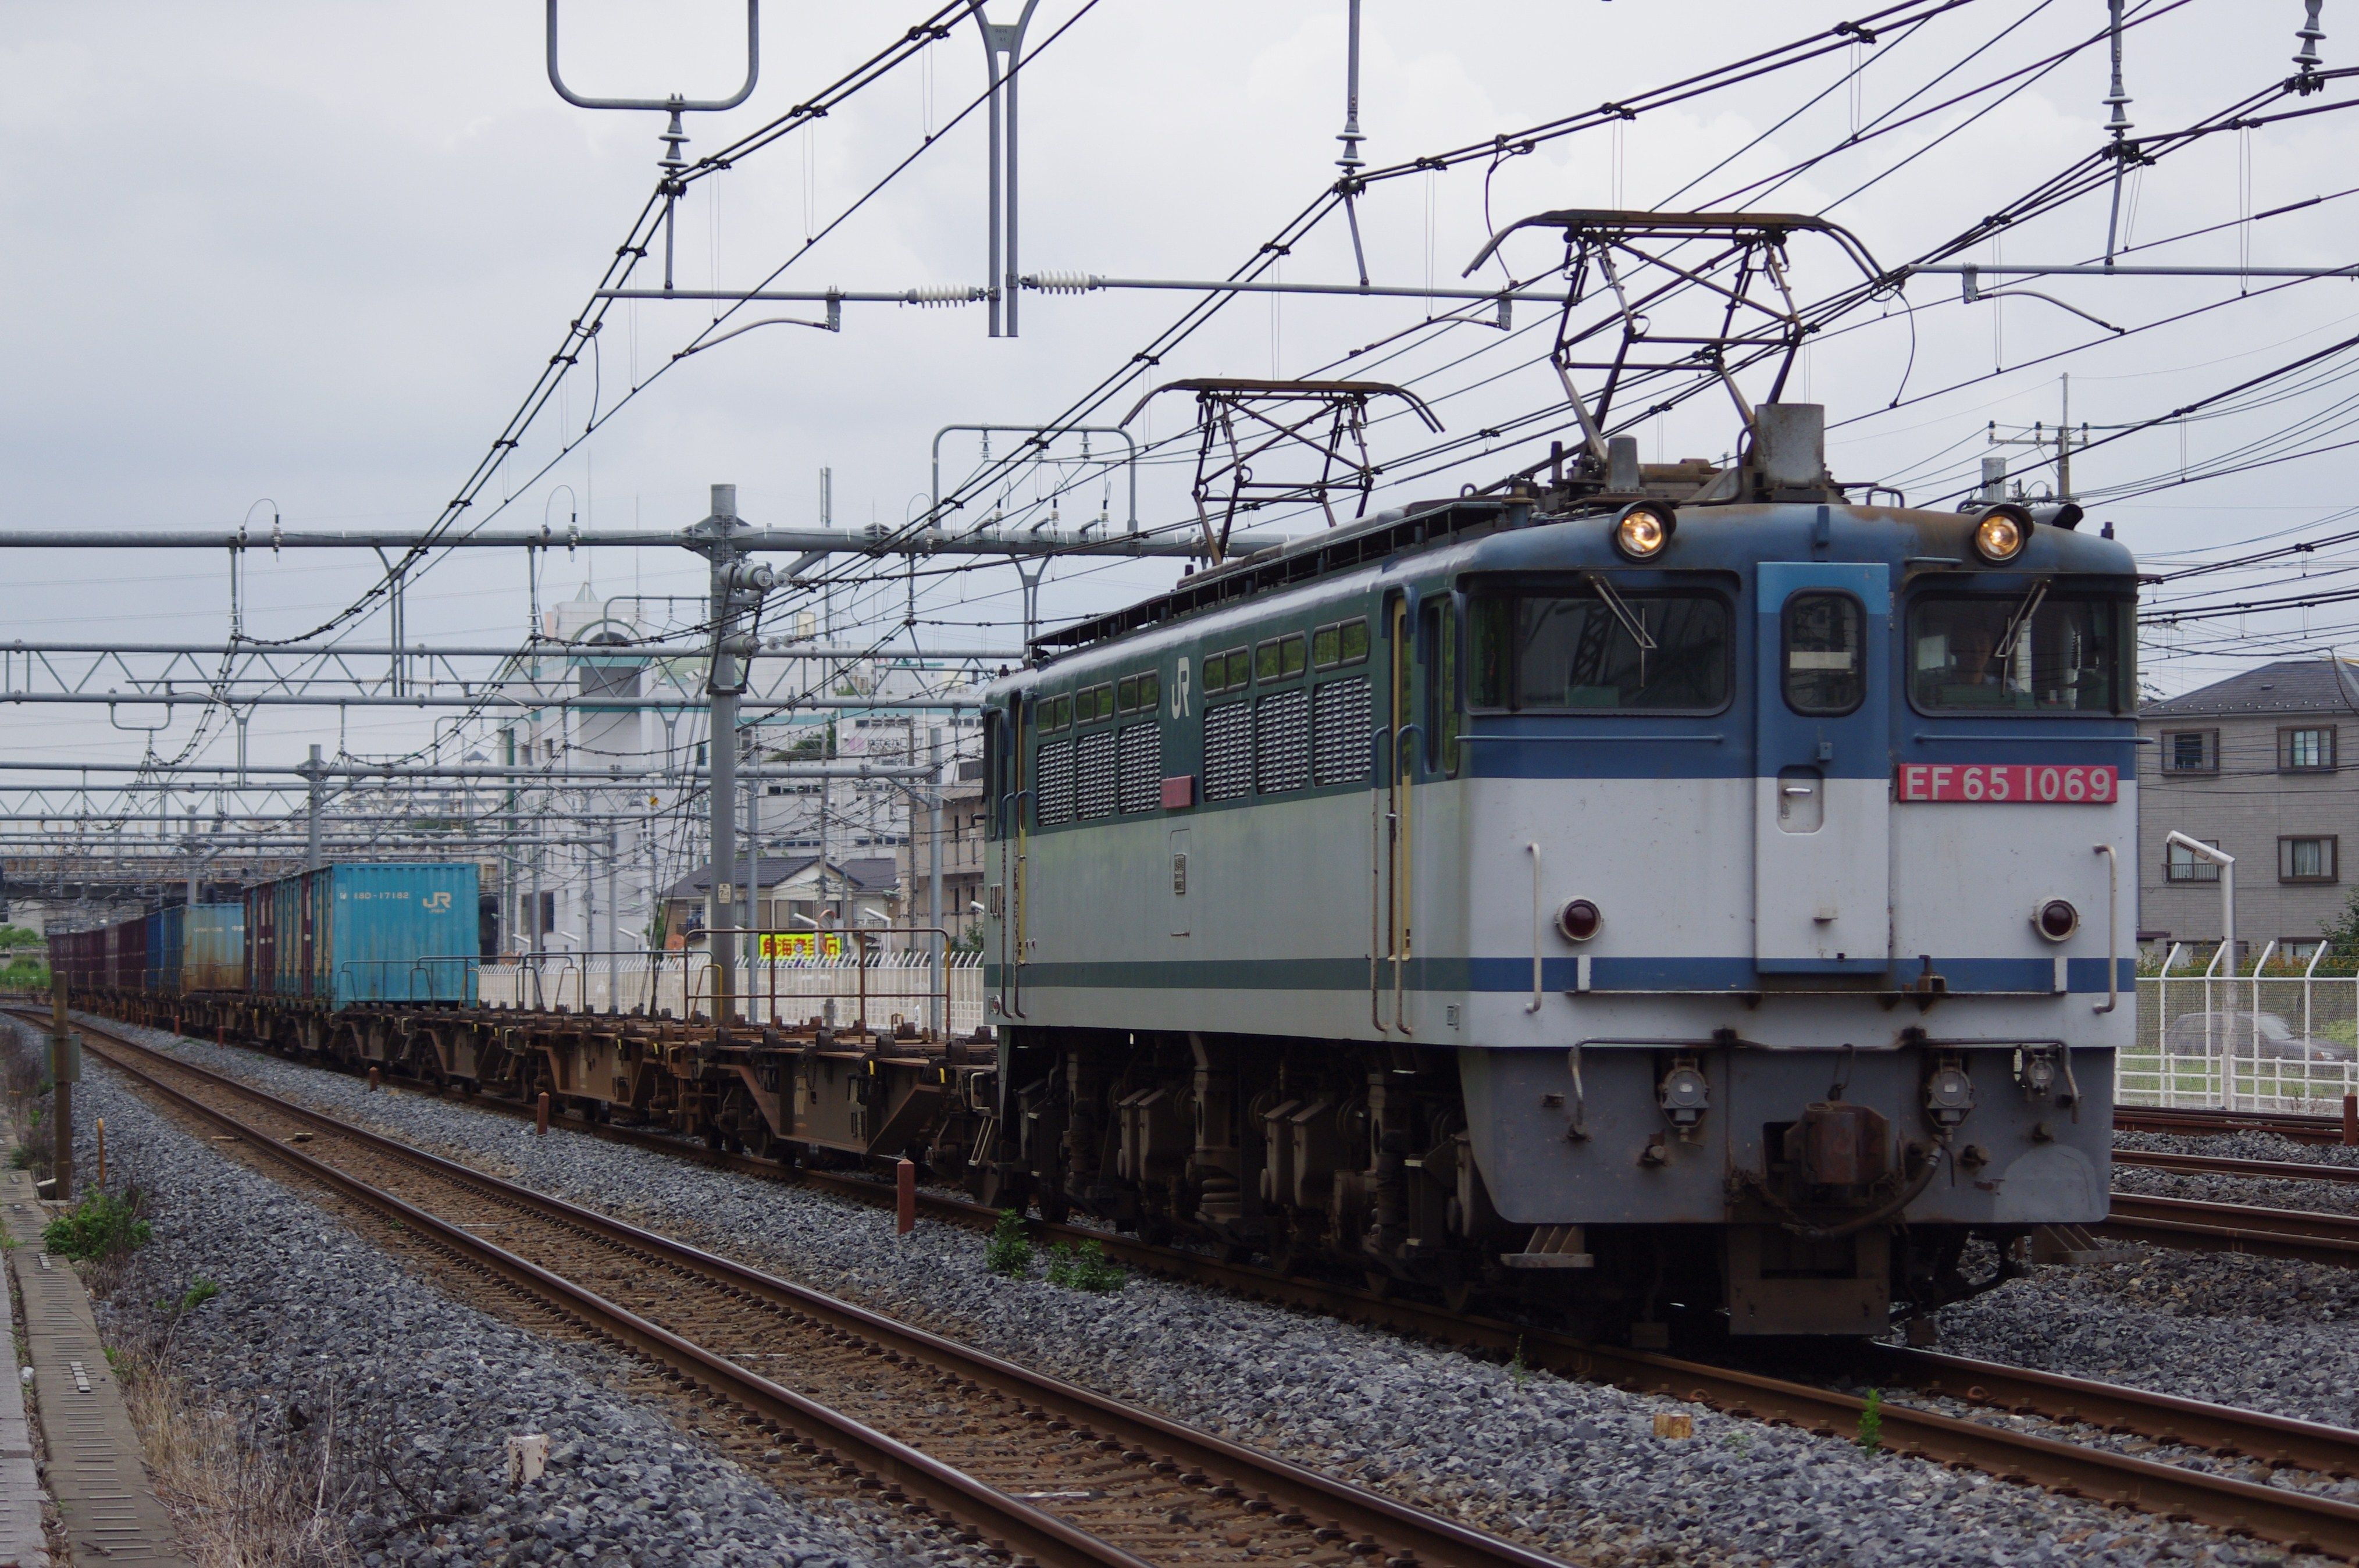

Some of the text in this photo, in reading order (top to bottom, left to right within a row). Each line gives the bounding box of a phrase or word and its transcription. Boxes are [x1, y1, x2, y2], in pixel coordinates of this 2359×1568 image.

[1171, 657, 1190, 719] JR
[1907, 767, 2111, 801] EF 65 1069
[423, 892, 451, 908] JR
